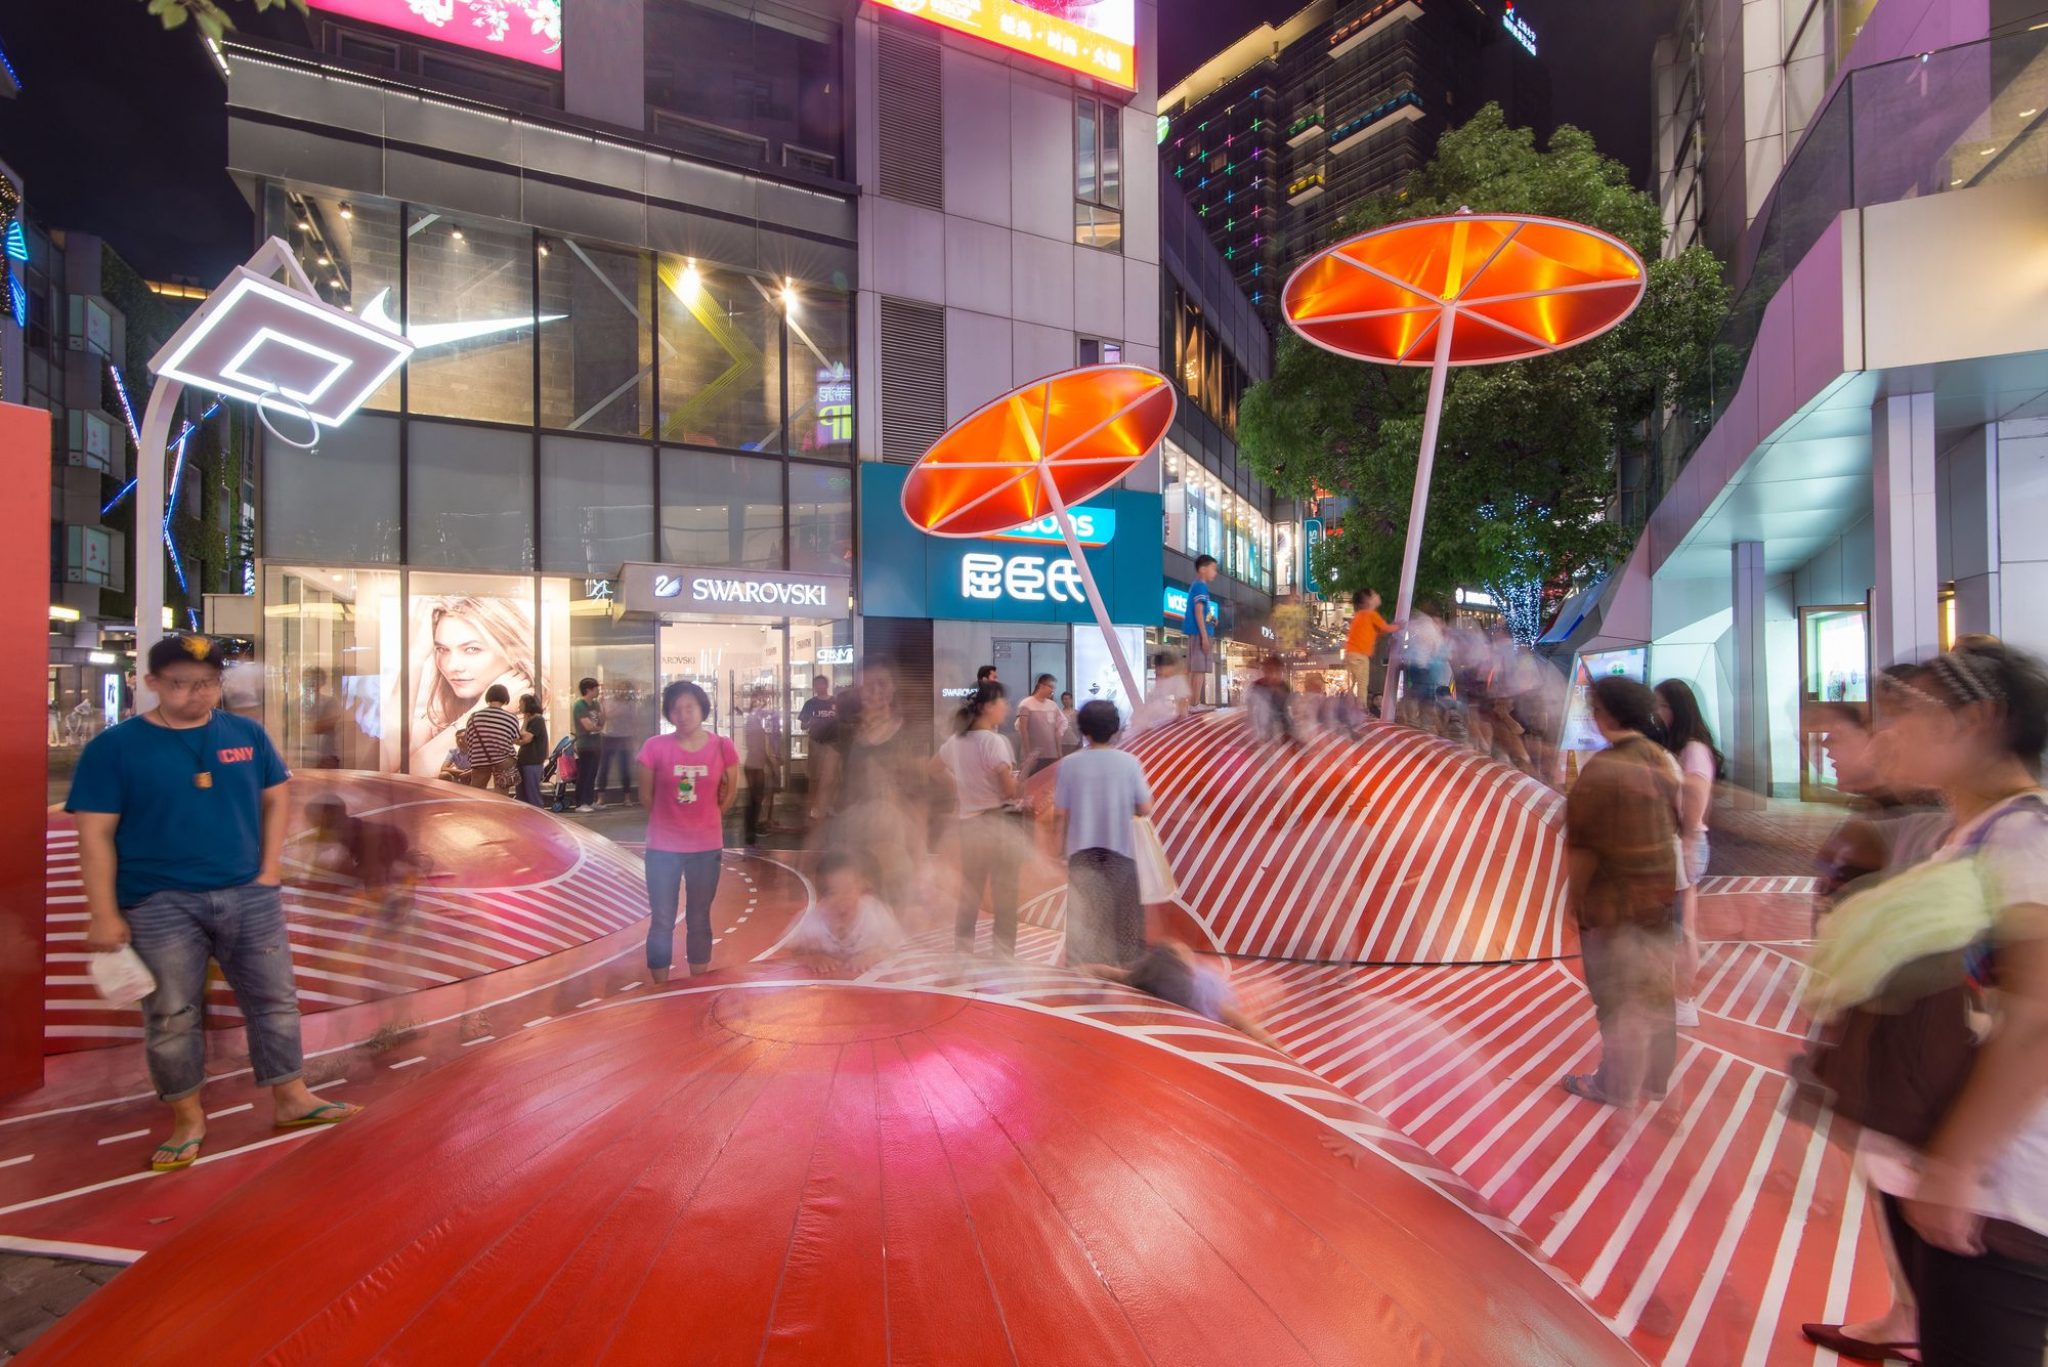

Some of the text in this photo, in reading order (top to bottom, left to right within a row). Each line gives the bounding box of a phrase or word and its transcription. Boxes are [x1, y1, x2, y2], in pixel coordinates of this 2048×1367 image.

[692, 578, 826, 606] SWAROVSKI
[962, 553, 1085, 603] 屈臣氏
[662, 655, 696, 665] AROVSKI
